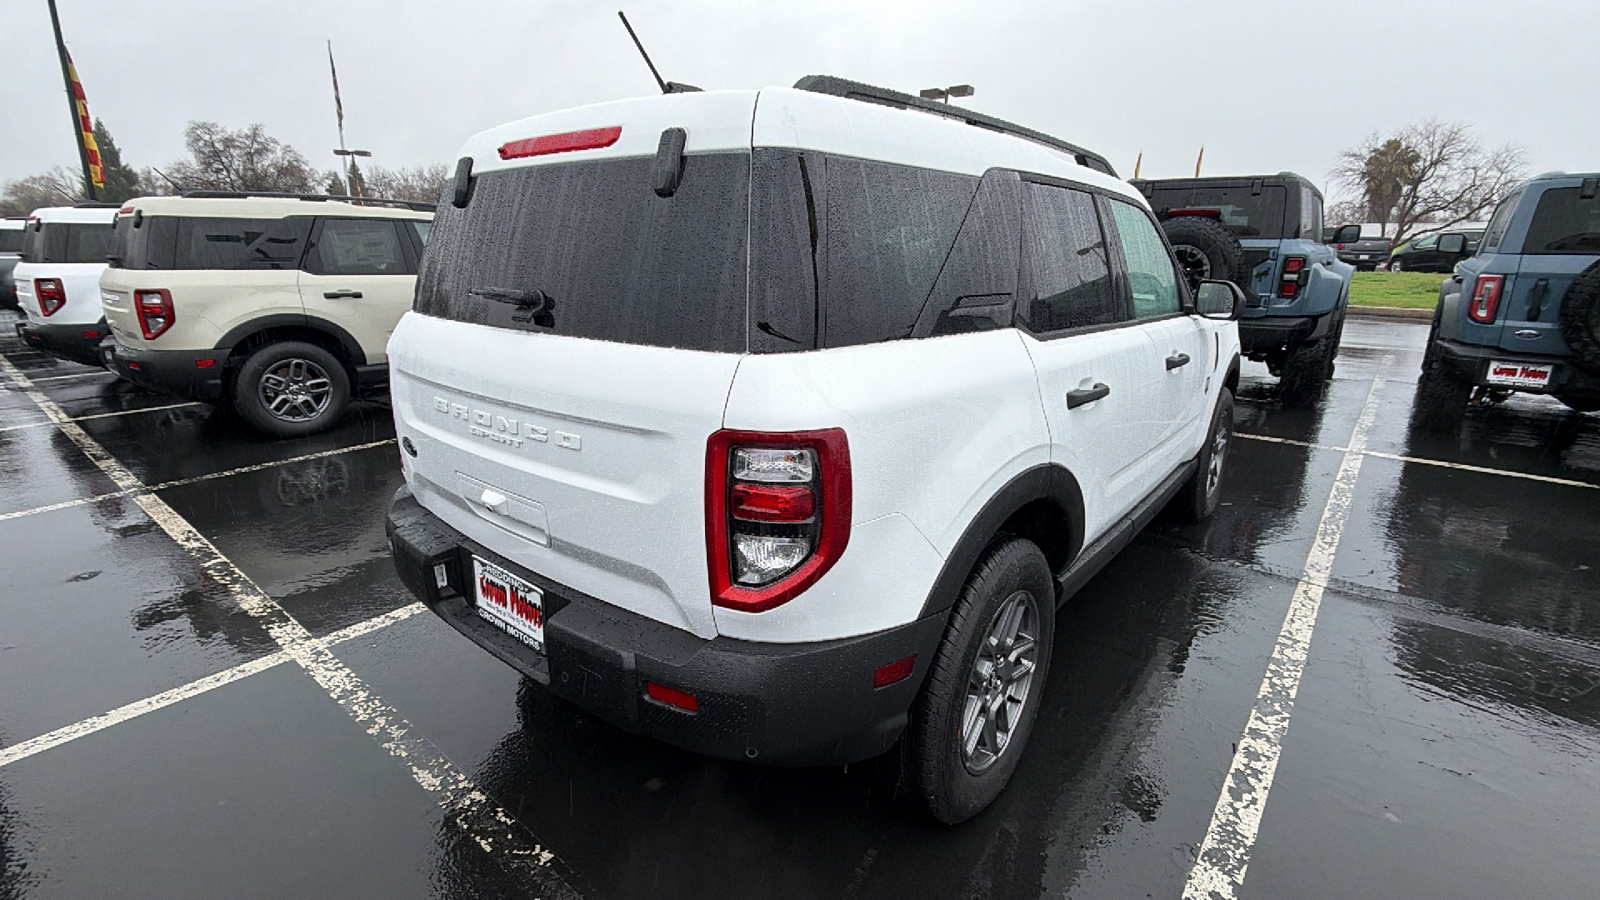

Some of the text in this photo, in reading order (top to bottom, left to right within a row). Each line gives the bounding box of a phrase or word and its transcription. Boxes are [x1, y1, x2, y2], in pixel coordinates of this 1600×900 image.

[433, 396, 582, 450] BRONCO
[469, 425, 523, 448] SPORT
[487, 565, 523, 591] REDDING
[480, 575, 507, 609] Crown
[509, 585, 542, 629] Motors
[479, 608, 506, 631] CROWN
[507, 623, 540, 651] MOTORS
